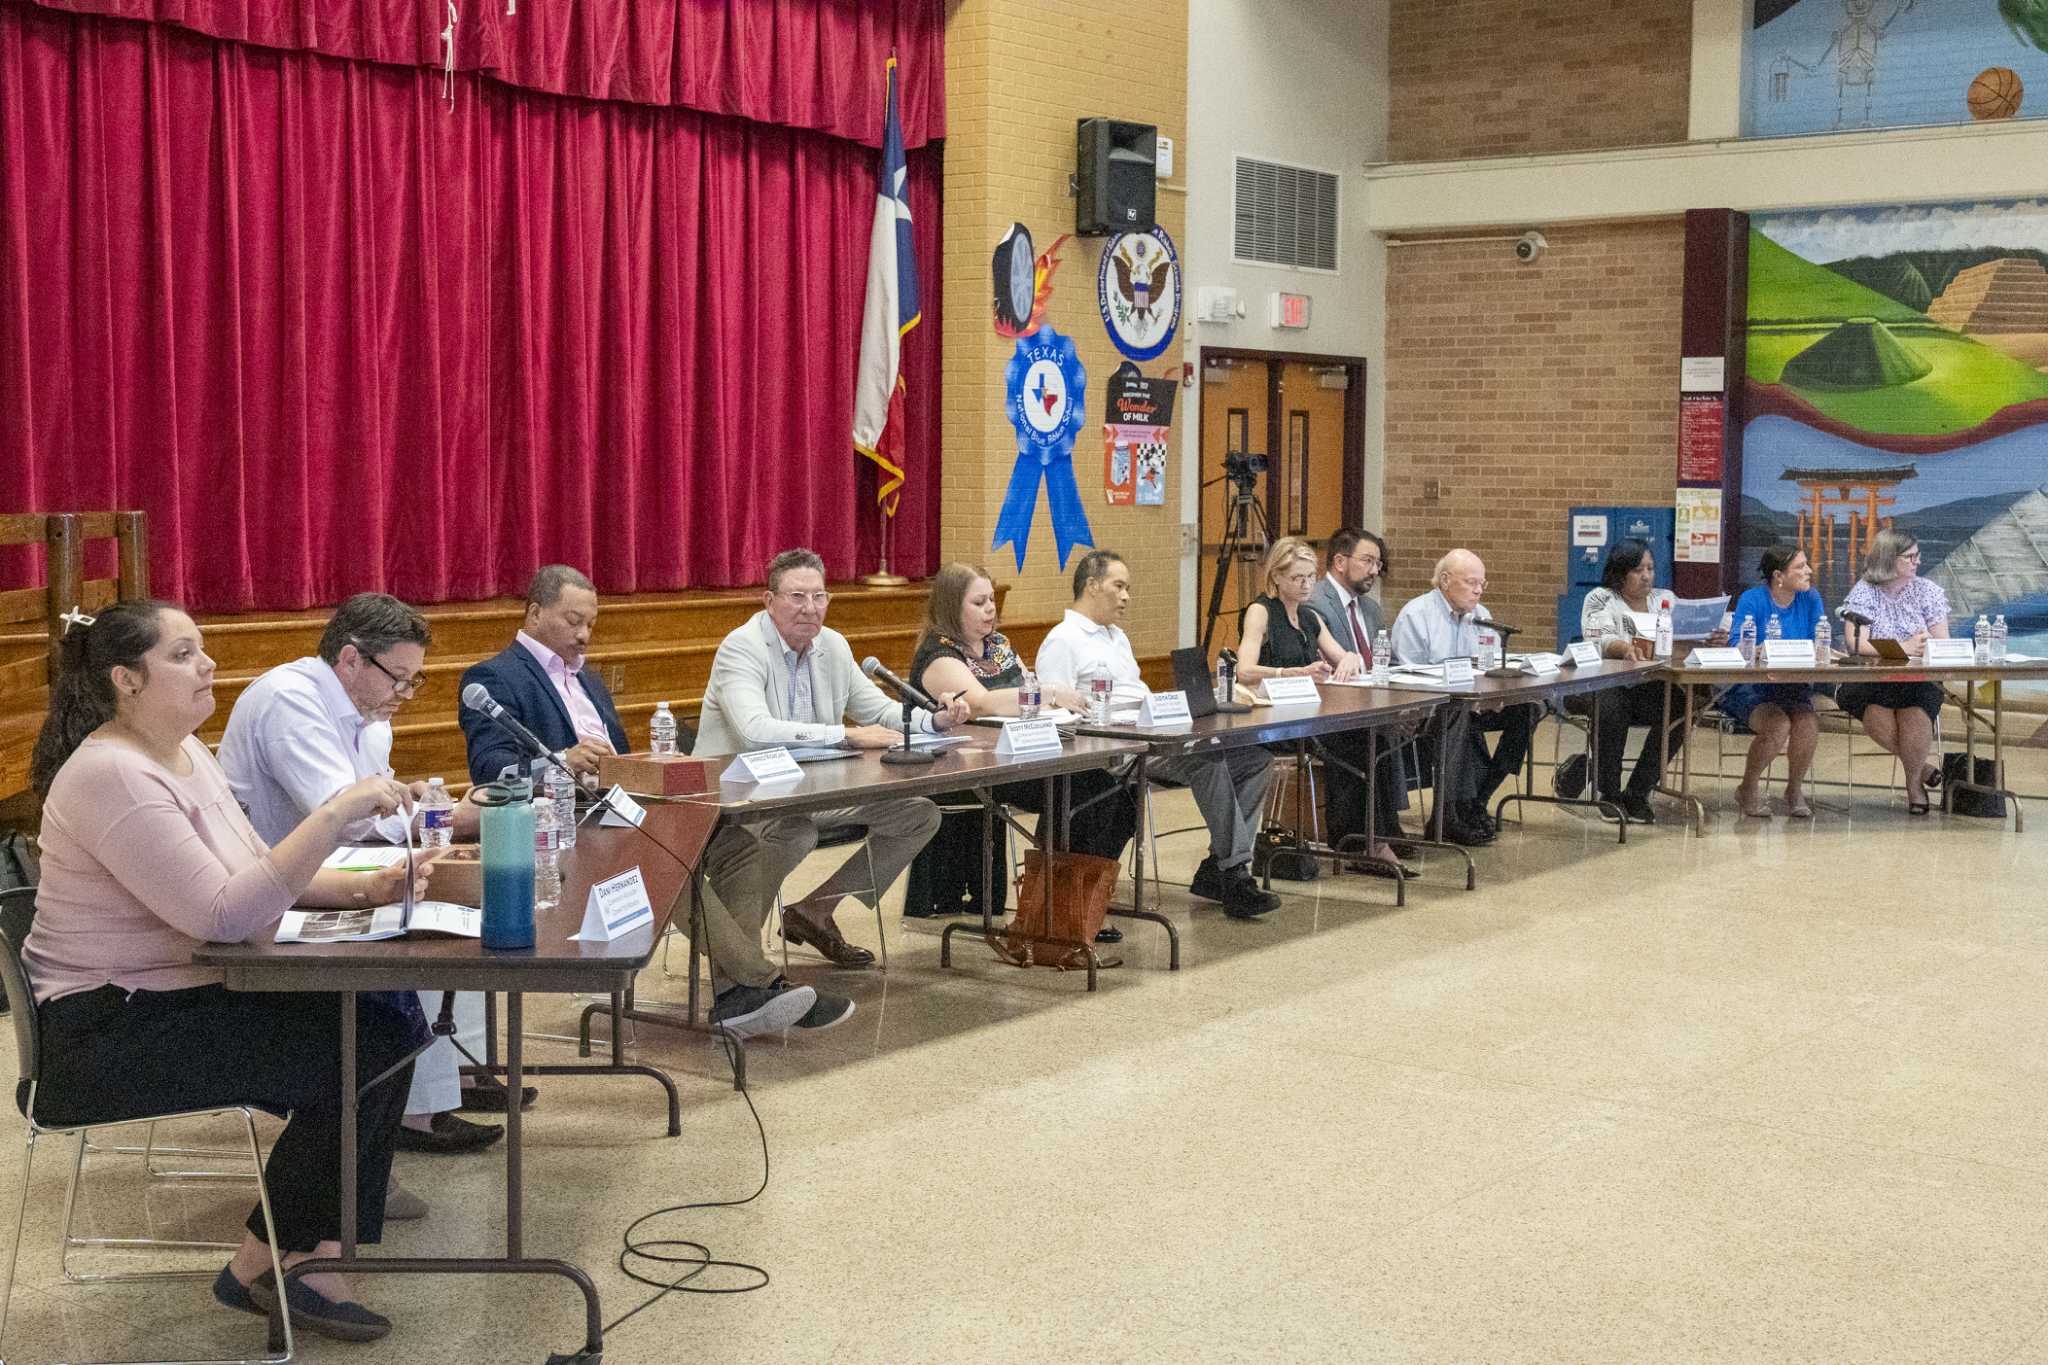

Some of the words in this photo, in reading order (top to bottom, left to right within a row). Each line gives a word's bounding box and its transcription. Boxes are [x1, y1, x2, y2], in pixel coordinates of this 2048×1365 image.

[1027, 346, 1064, 367] TEXAS
[1117, 398, 1157, 413] Wonder
[1016, 394, 1032, 435] National
[1030, 430, 1046, 446] Blue
[1123, 412, 1132, 421] OF
[1132, 412, 1150, 422] MILK
